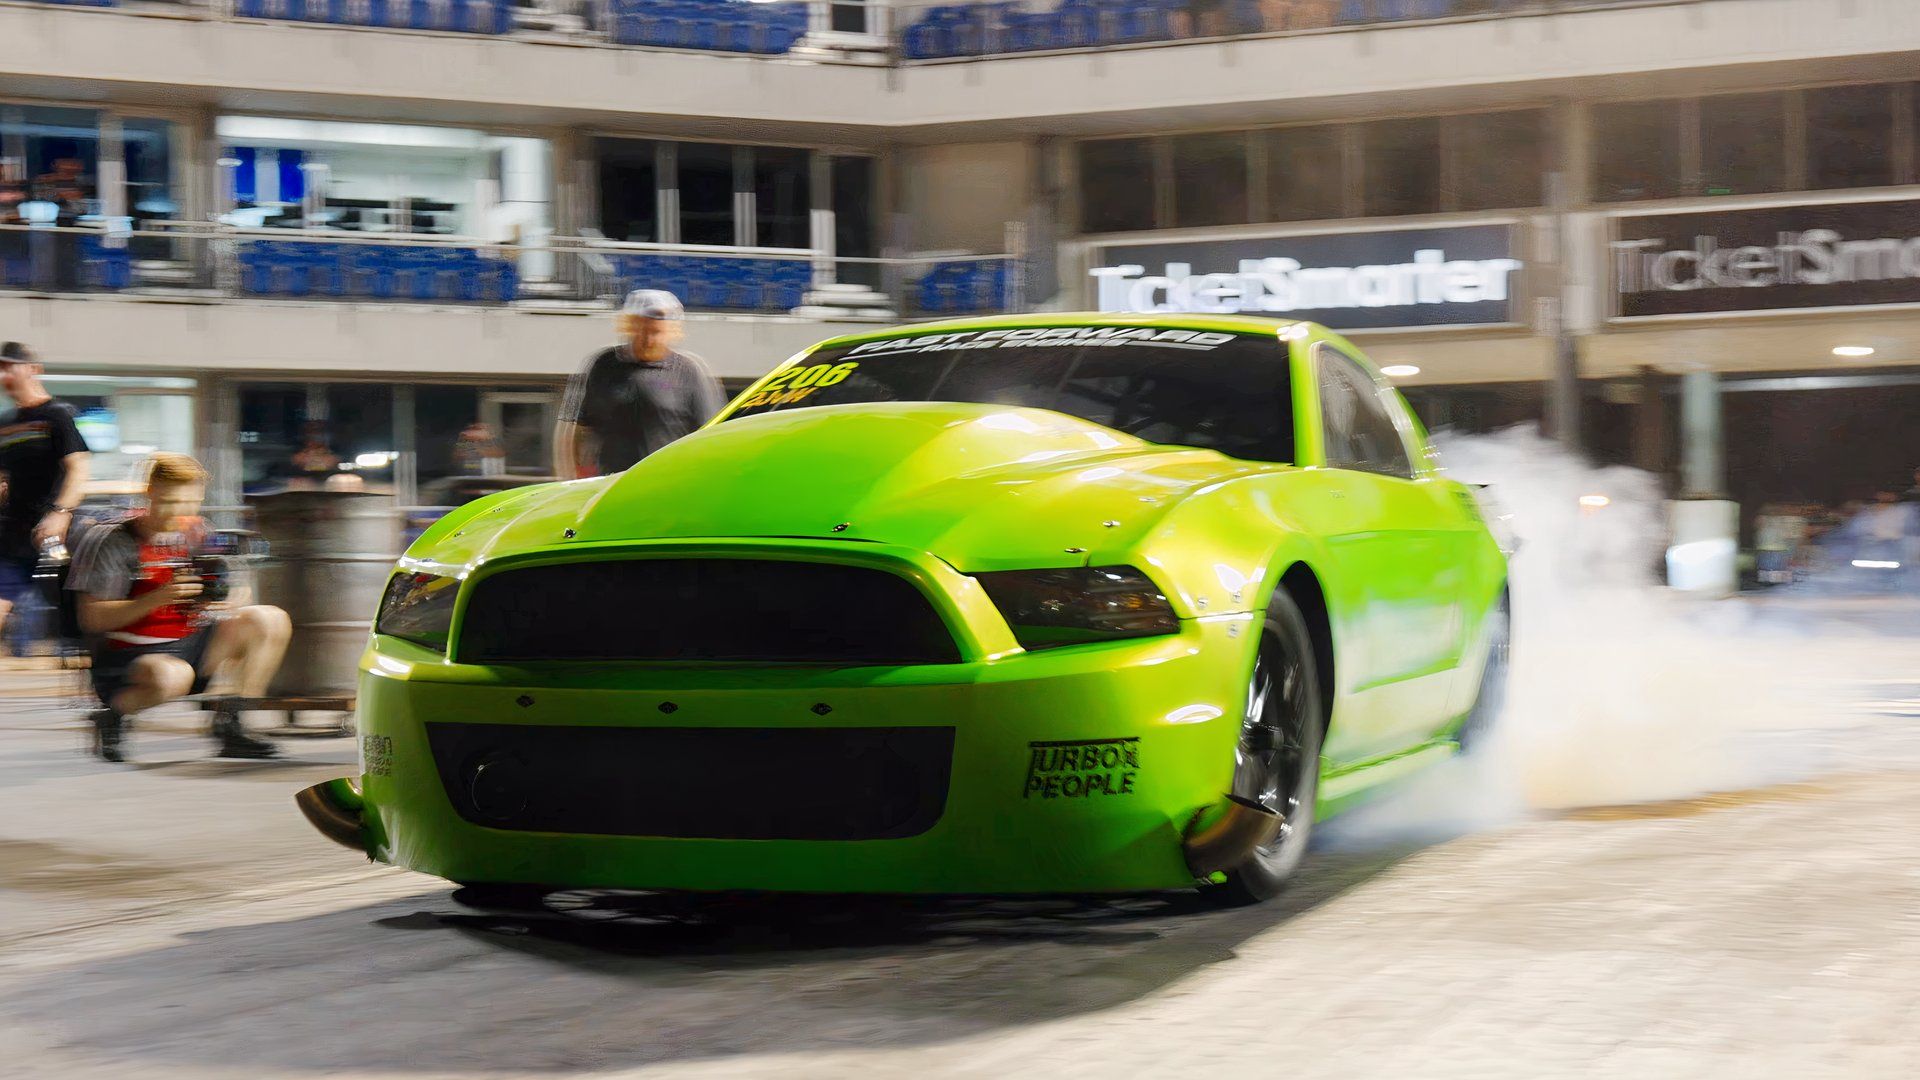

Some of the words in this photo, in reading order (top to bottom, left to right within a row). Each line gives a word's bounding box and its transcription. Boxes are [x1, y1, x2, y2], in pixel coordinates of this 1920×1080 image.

[1089, 249, 1524, 313] TicketSmarter
[848, 331, 980, 355] FAST
[973, 327, 1237, 346] FORWARD
[917, 339, 1001, 354] RACE
[999, 338, 1131, 349] ENGINES
[761, 362, 859, 389] 206
[1023, 772, 1136, 799] PEOPLE
